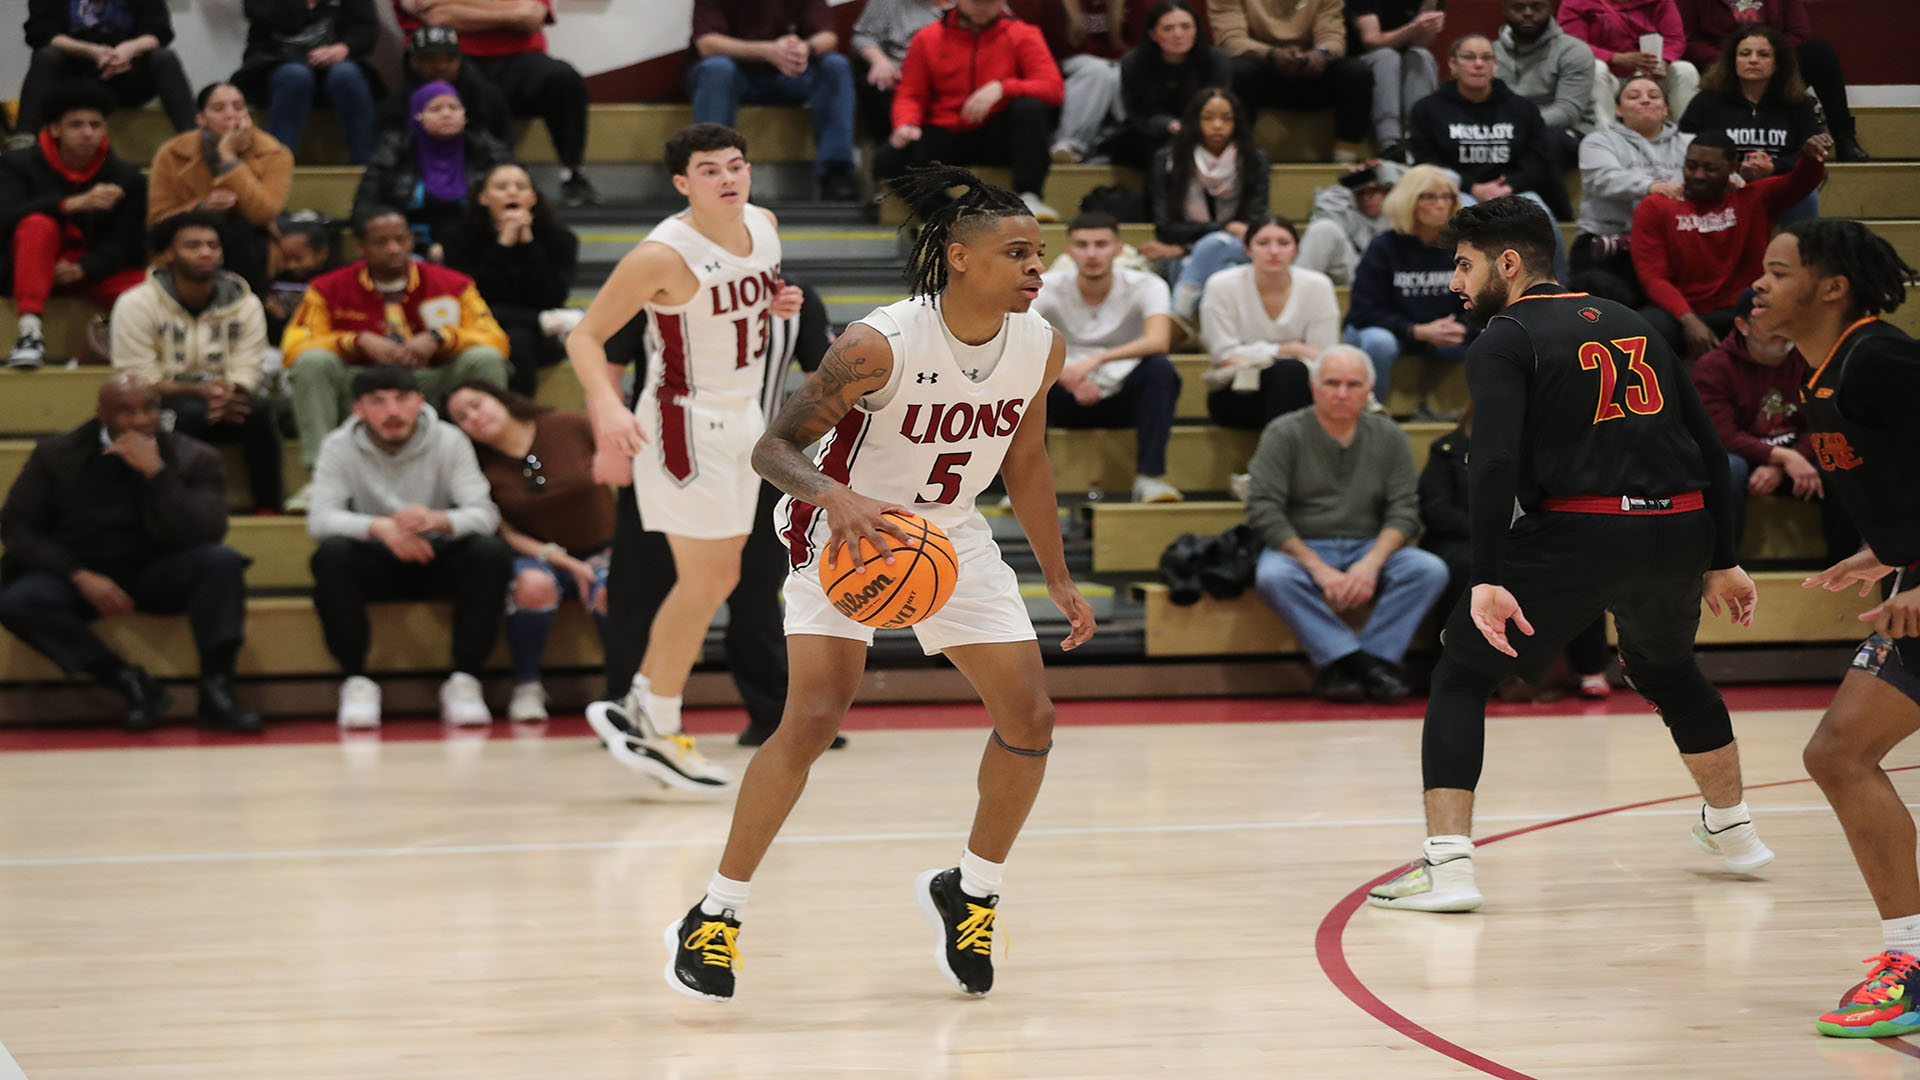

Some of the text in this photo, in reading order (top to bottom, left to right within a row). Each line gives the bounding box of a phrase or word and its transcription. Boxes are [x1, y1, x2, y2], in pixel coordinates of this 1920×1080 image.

[1448, 123, 1514, 139] MOLLOY
[1458, 145, 1510, 163] LIONS
[1726, 128, 1787, 146] MOLLOY
[710, 263, 780, 316] LION
[731, 308, 768, 370] 13
[1578, 336, 1664, 424] 23
[899, 398, 1024, 444] LIONS
[914, 451, 972, 505] 5
